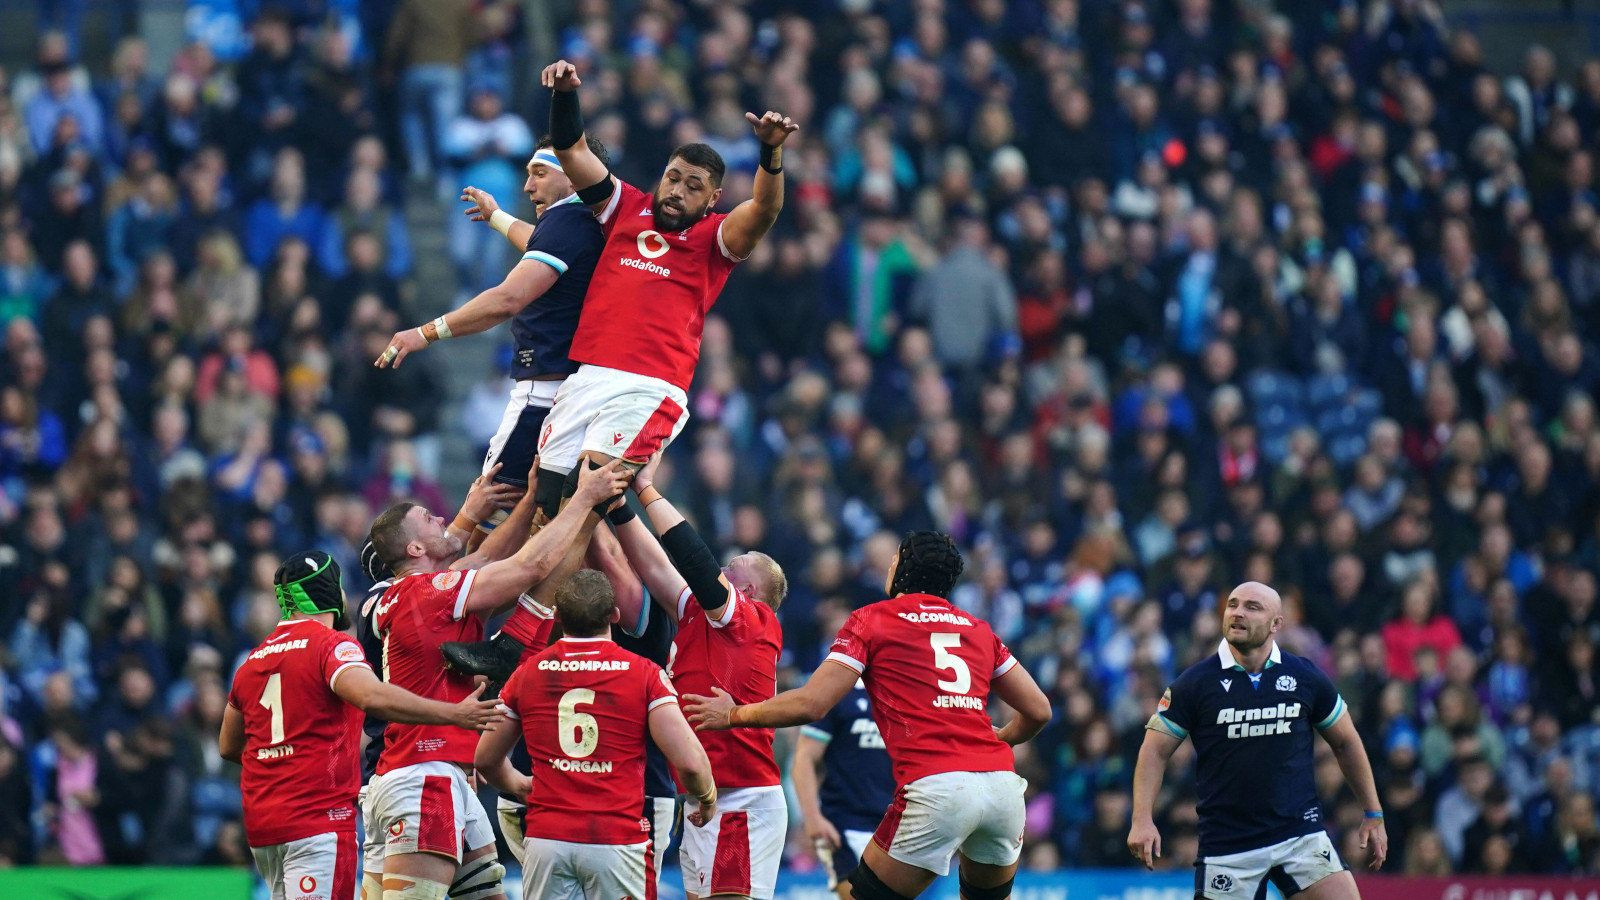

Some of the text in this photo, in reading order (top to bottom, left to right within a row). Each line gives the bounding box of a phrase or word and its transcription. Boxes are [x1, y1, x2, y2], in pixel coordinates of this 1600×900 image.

[620, 257, 671, 277] vodafone
[538, 660, 630, 672] GO.COMPARE
[930, 632, 971, 695] 5
[259, 672, 285, 744] 1
[932, 695, 983, 711] JENKINS
[558, 687, 599, 758] 6
[1216, 702, 1302, 725] Arnold
[1227, 719, 1292, 739] Clark
[257, 744, 294, 760] SMITH
[549, 758, 613, 773] MORGAN
